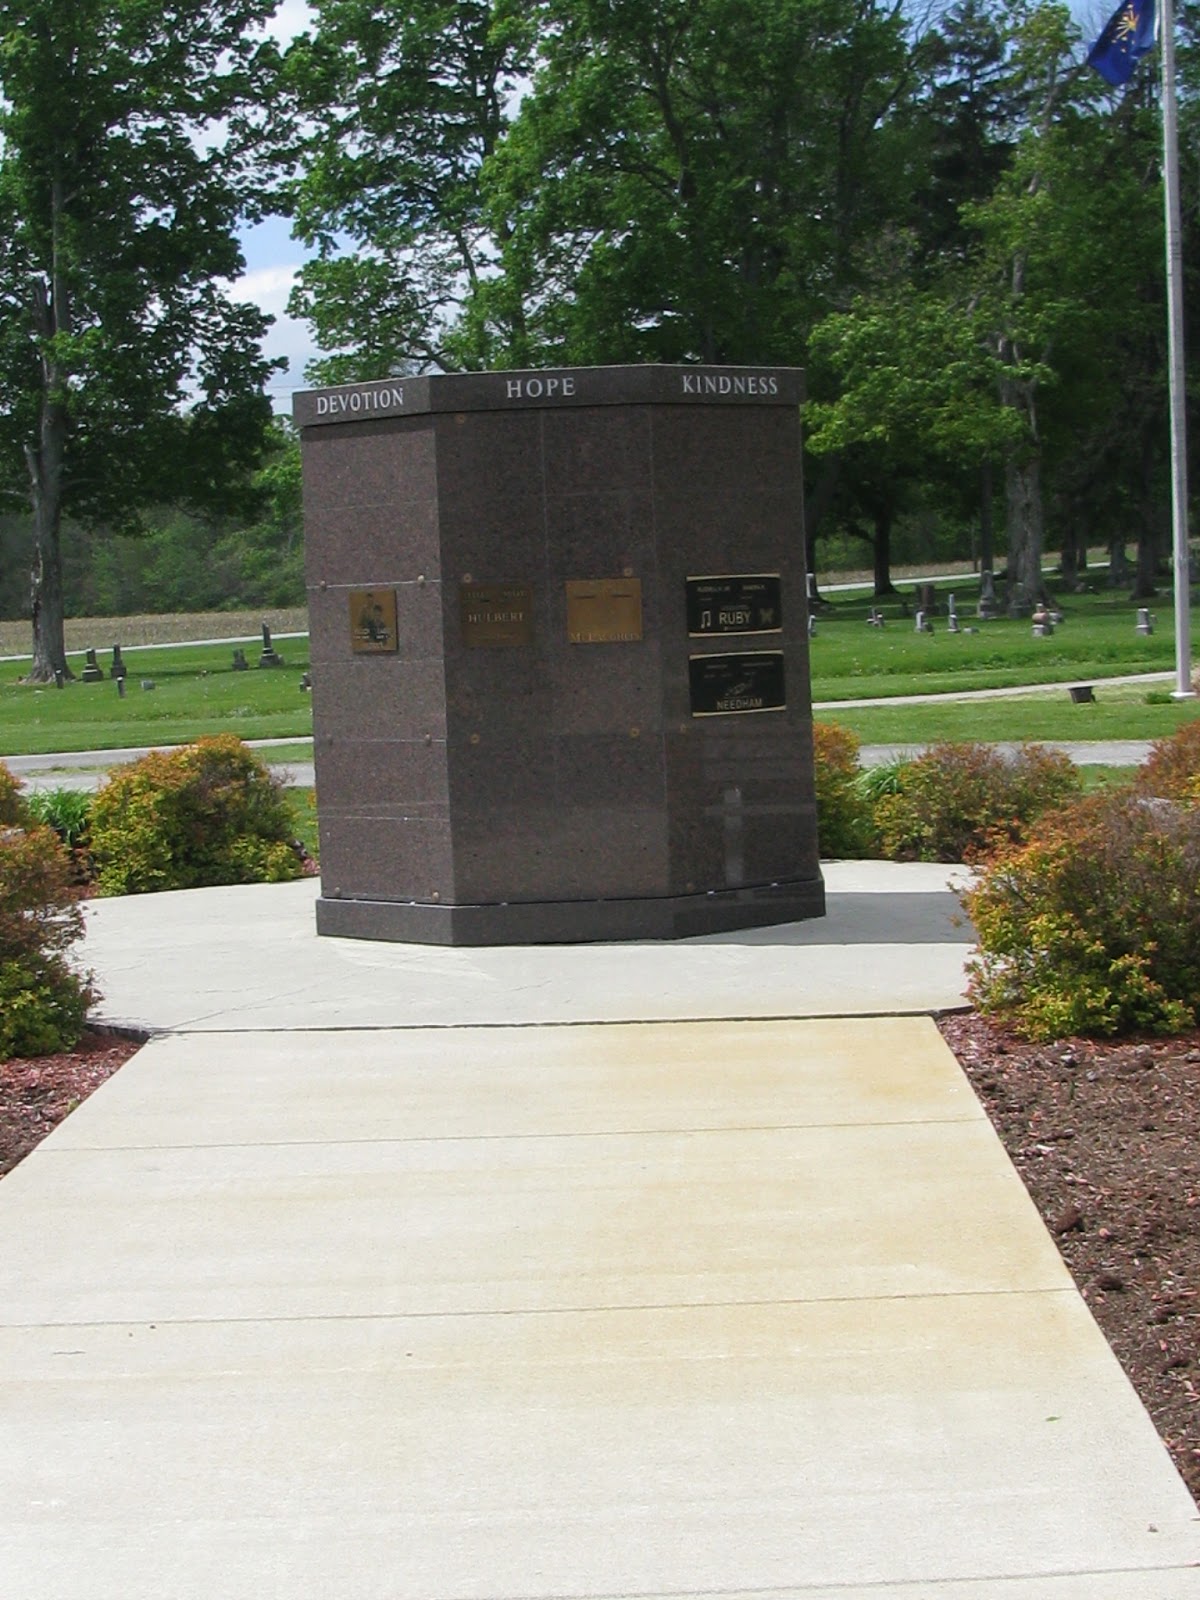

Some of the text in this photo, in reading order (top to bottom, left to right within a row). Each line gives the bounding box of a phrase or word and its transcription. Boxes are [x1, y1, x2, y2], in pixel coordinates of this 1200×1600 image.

[506, 377, 576, 398] HOPE
[682, 375, 778, 394] KINDNESS
[316, 387, 404, 415] DEVOTION
[468, 612, 524, 624] HULBERT
[719, 611, 751, 624] RUBY
[717, 698, 762, 710] NEEDHAM
